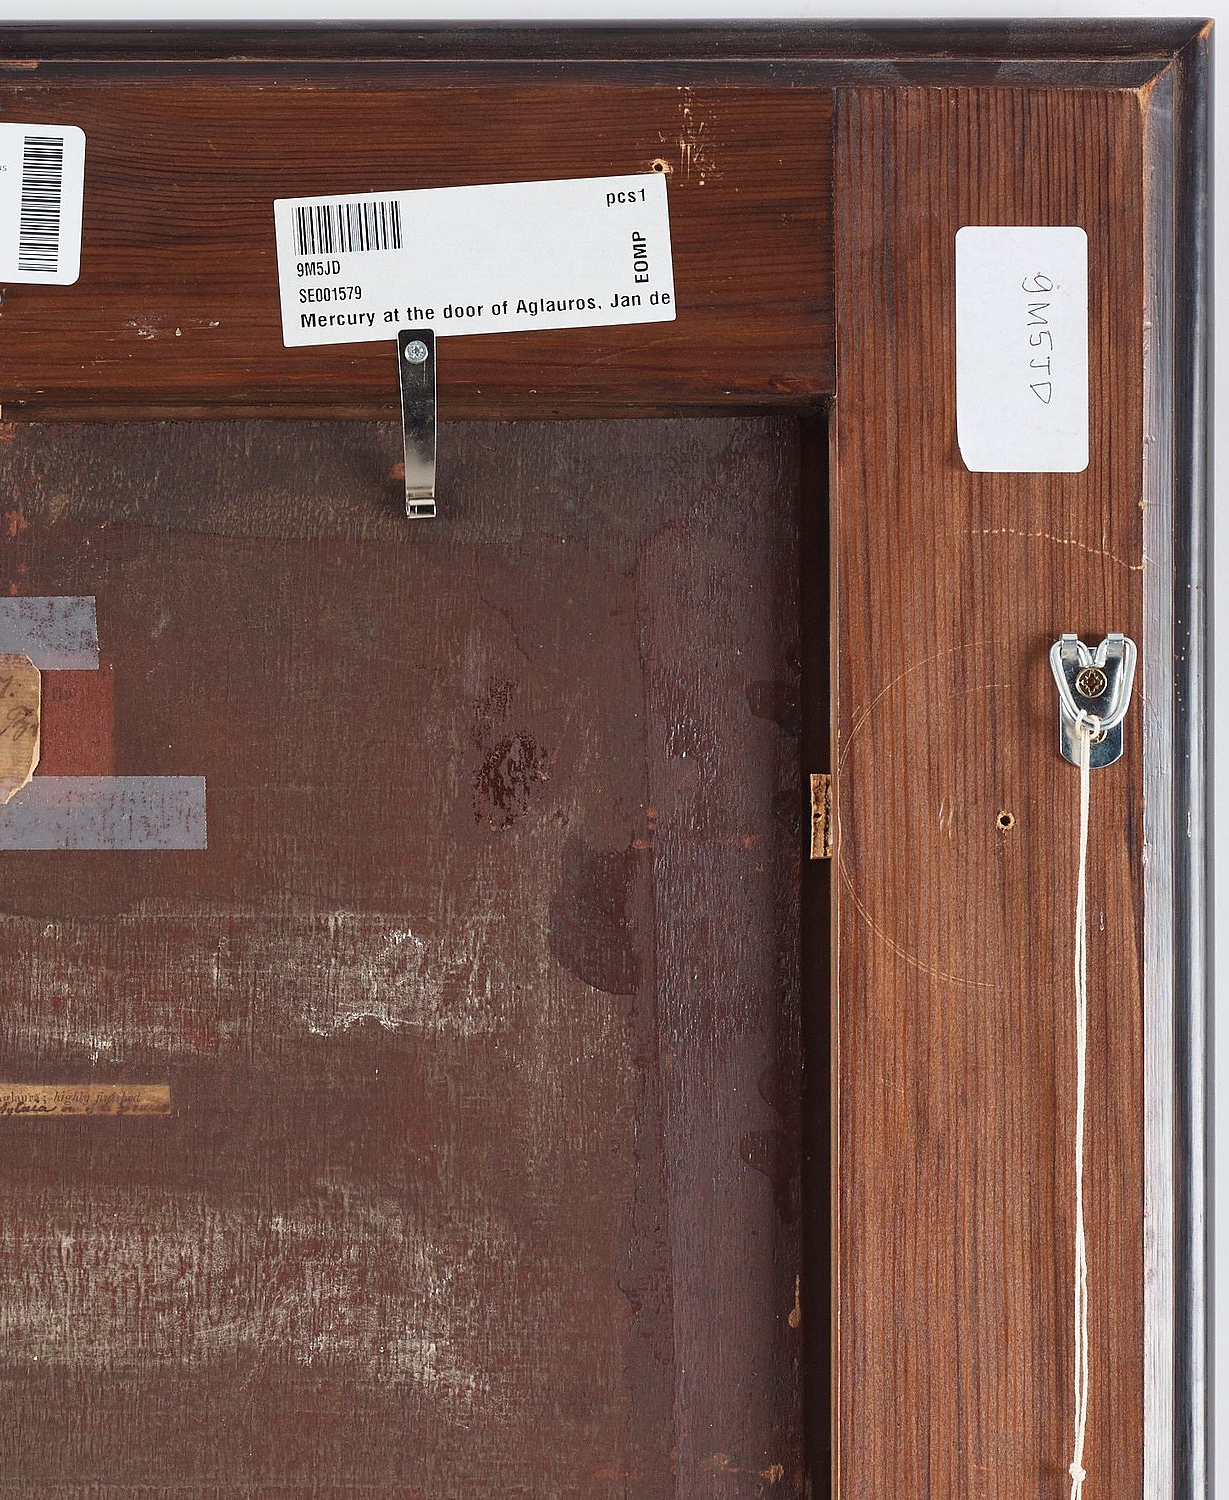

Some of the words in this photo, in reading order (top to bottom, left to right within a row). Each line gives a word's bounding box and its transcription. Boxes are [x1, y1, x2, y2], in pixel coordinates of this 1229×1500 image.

[632, 231, 649, 284] EOMP
[296, 260, 341, 277] 9M5JD
[299, 286, 362, 304] SE001579
[300, 311, 375, 328] Mercury
[383, 308, 400, 323] at
[406, 306, 435, 321] the
[443, 303, 484, 319] door
[491, 301, 509, 316] of
[610, 292, 642, 309] Jan
[649, 290, 671, 306] de
[53, 1091, 90, 1106] highly
